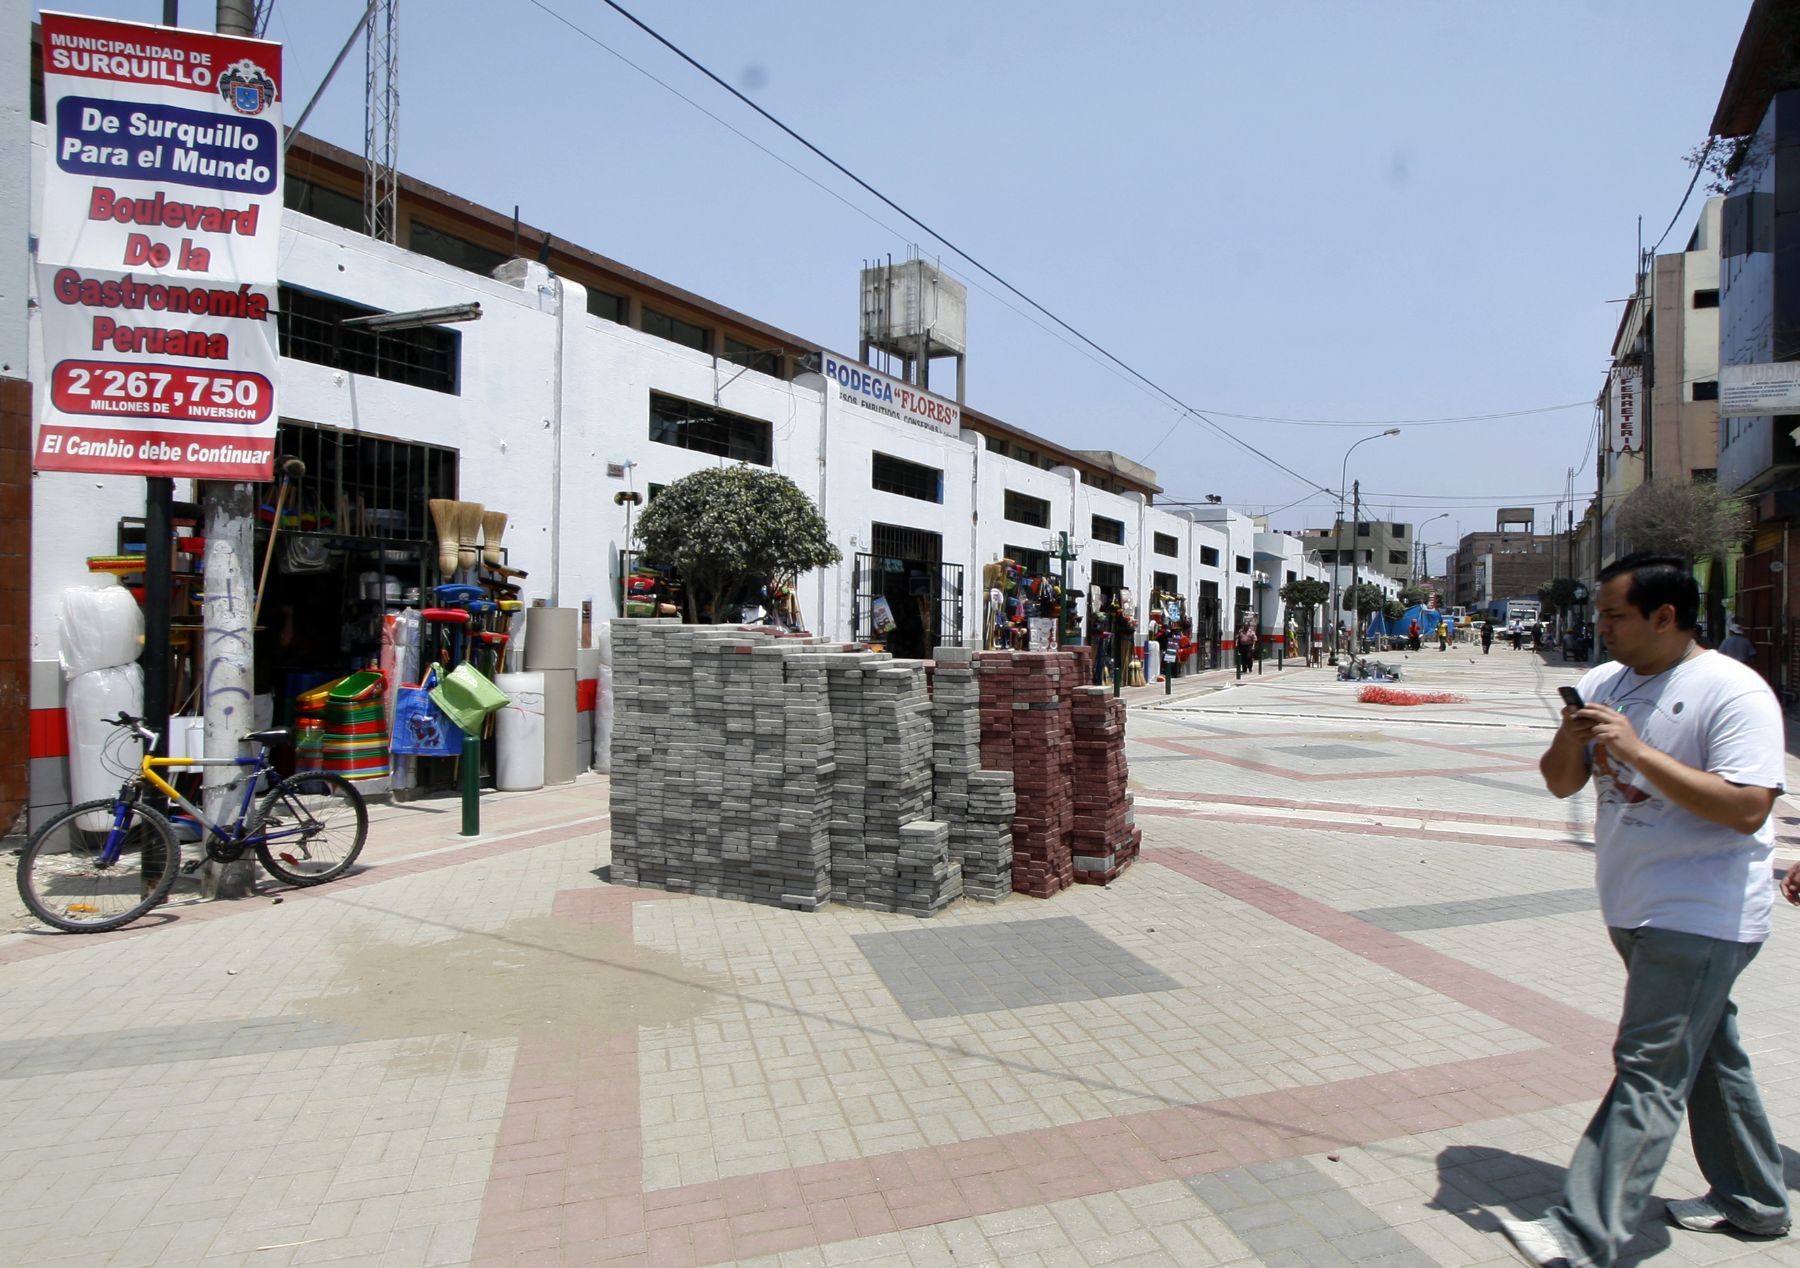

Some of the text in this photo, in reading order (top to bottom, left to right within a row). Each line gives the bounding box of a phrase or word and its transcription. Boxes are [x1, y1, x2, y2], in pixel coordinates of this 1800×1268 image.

[51, 33, 212, 65] MUNICIPALIDAD DE
[53, 49, 212, 86] SURQUILLO
[81, 107, 258, 151] De Surquillo
[61, 137, 270, 183] Para el Mundo
[88, 186, 260, 236] Boulevard
[123, 233, 211, 272] De la
[53, 267, 269, 321] Gastronomía
[92, 315, 229, 360] Peruana
[91, 399, 256, 419] MILLONES DE INVERSIÓN
[826, 359, 957, 425] BODEGA "FLORES"
[1620, 379, 1633, 451] FERRETERIA
[42, 434, 270, 465] El Cambio debe Continuar
